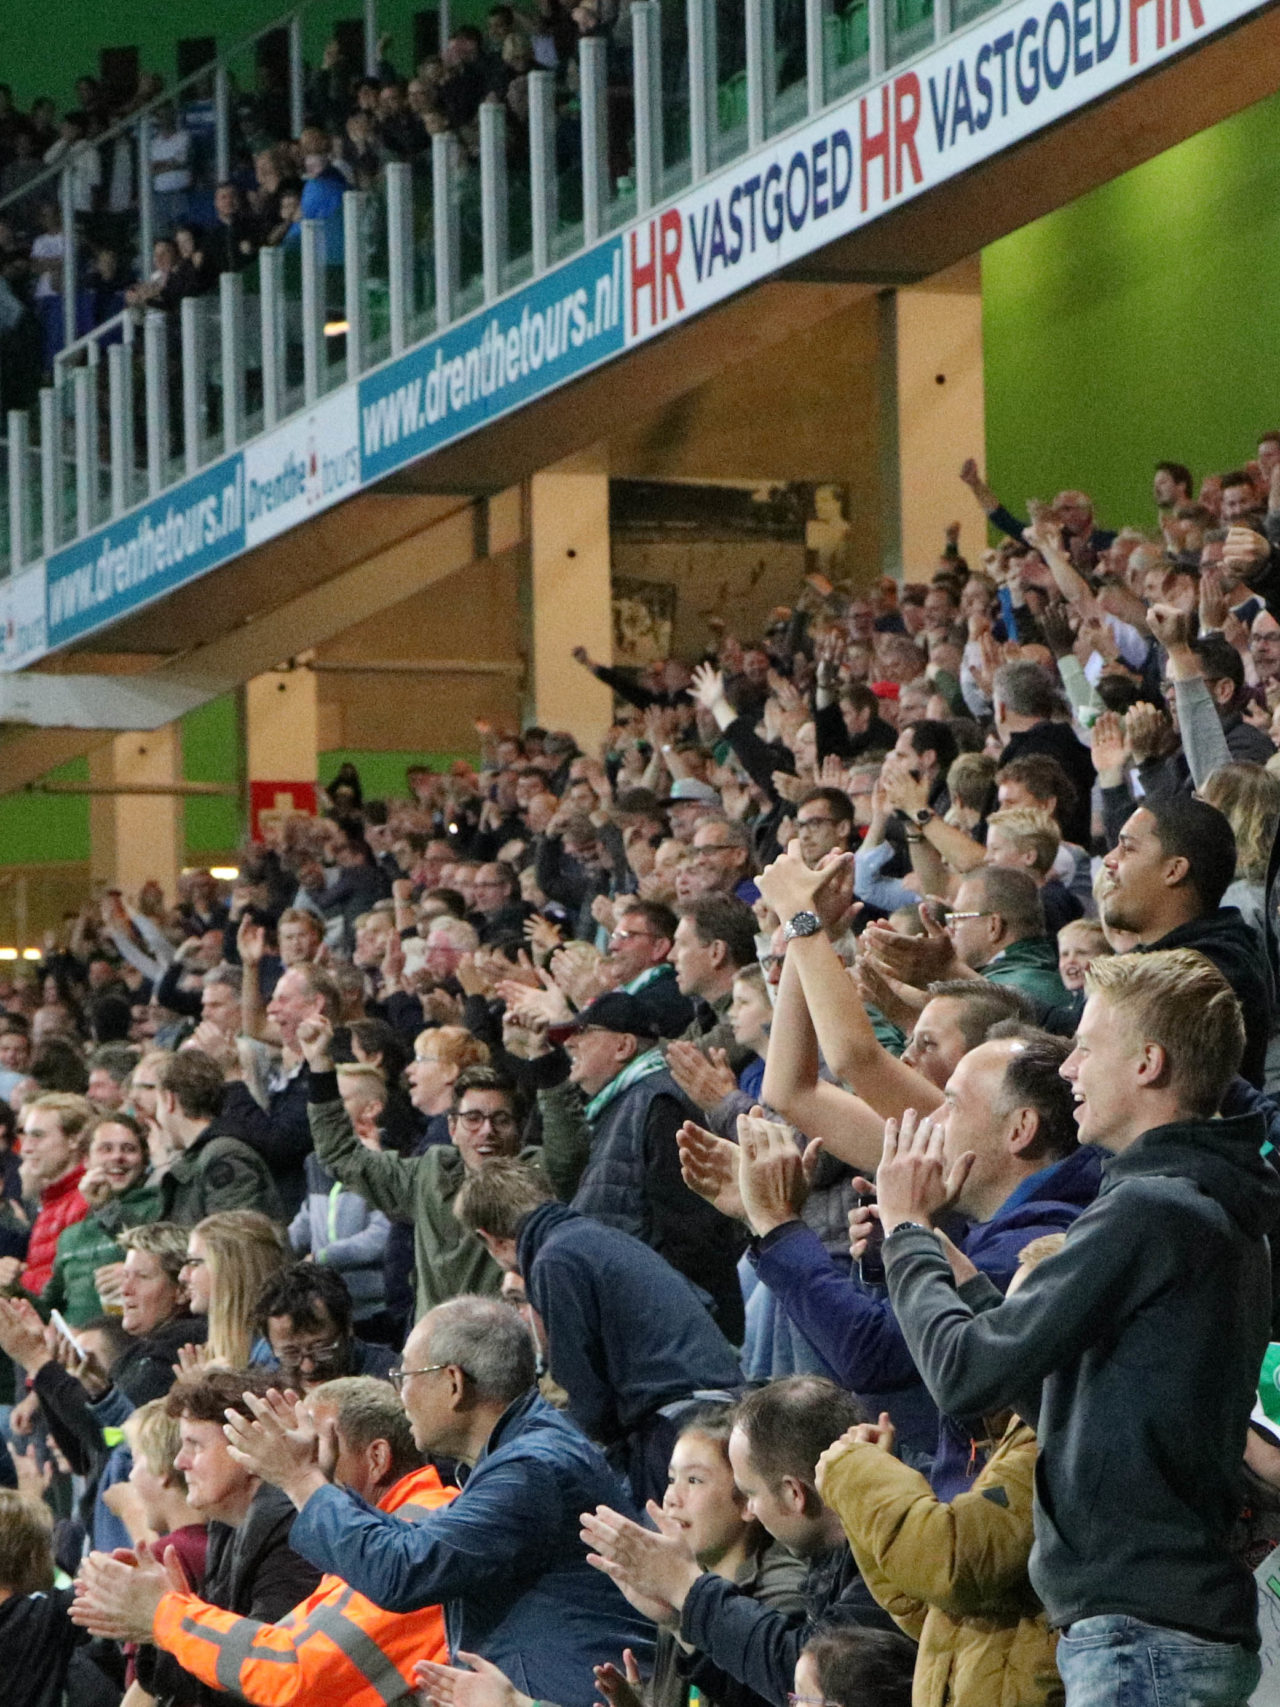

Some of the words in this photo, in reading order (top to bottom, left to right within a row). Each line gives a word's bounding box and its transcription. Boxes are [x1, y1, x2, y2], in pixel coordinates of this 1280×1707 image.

[630, 207, 686, 336] HR
[689, 128, 853, 282] VASTGOED
[859, 71, 924, 212] HR
[929, 0, 1121, 152] VASTGOED
[363, 248, 622, 456] www.drenthetours.nl
[48, 461, 244, 627] www.drenthetours.nl
[249, 450, 306, 521] Drenthe
